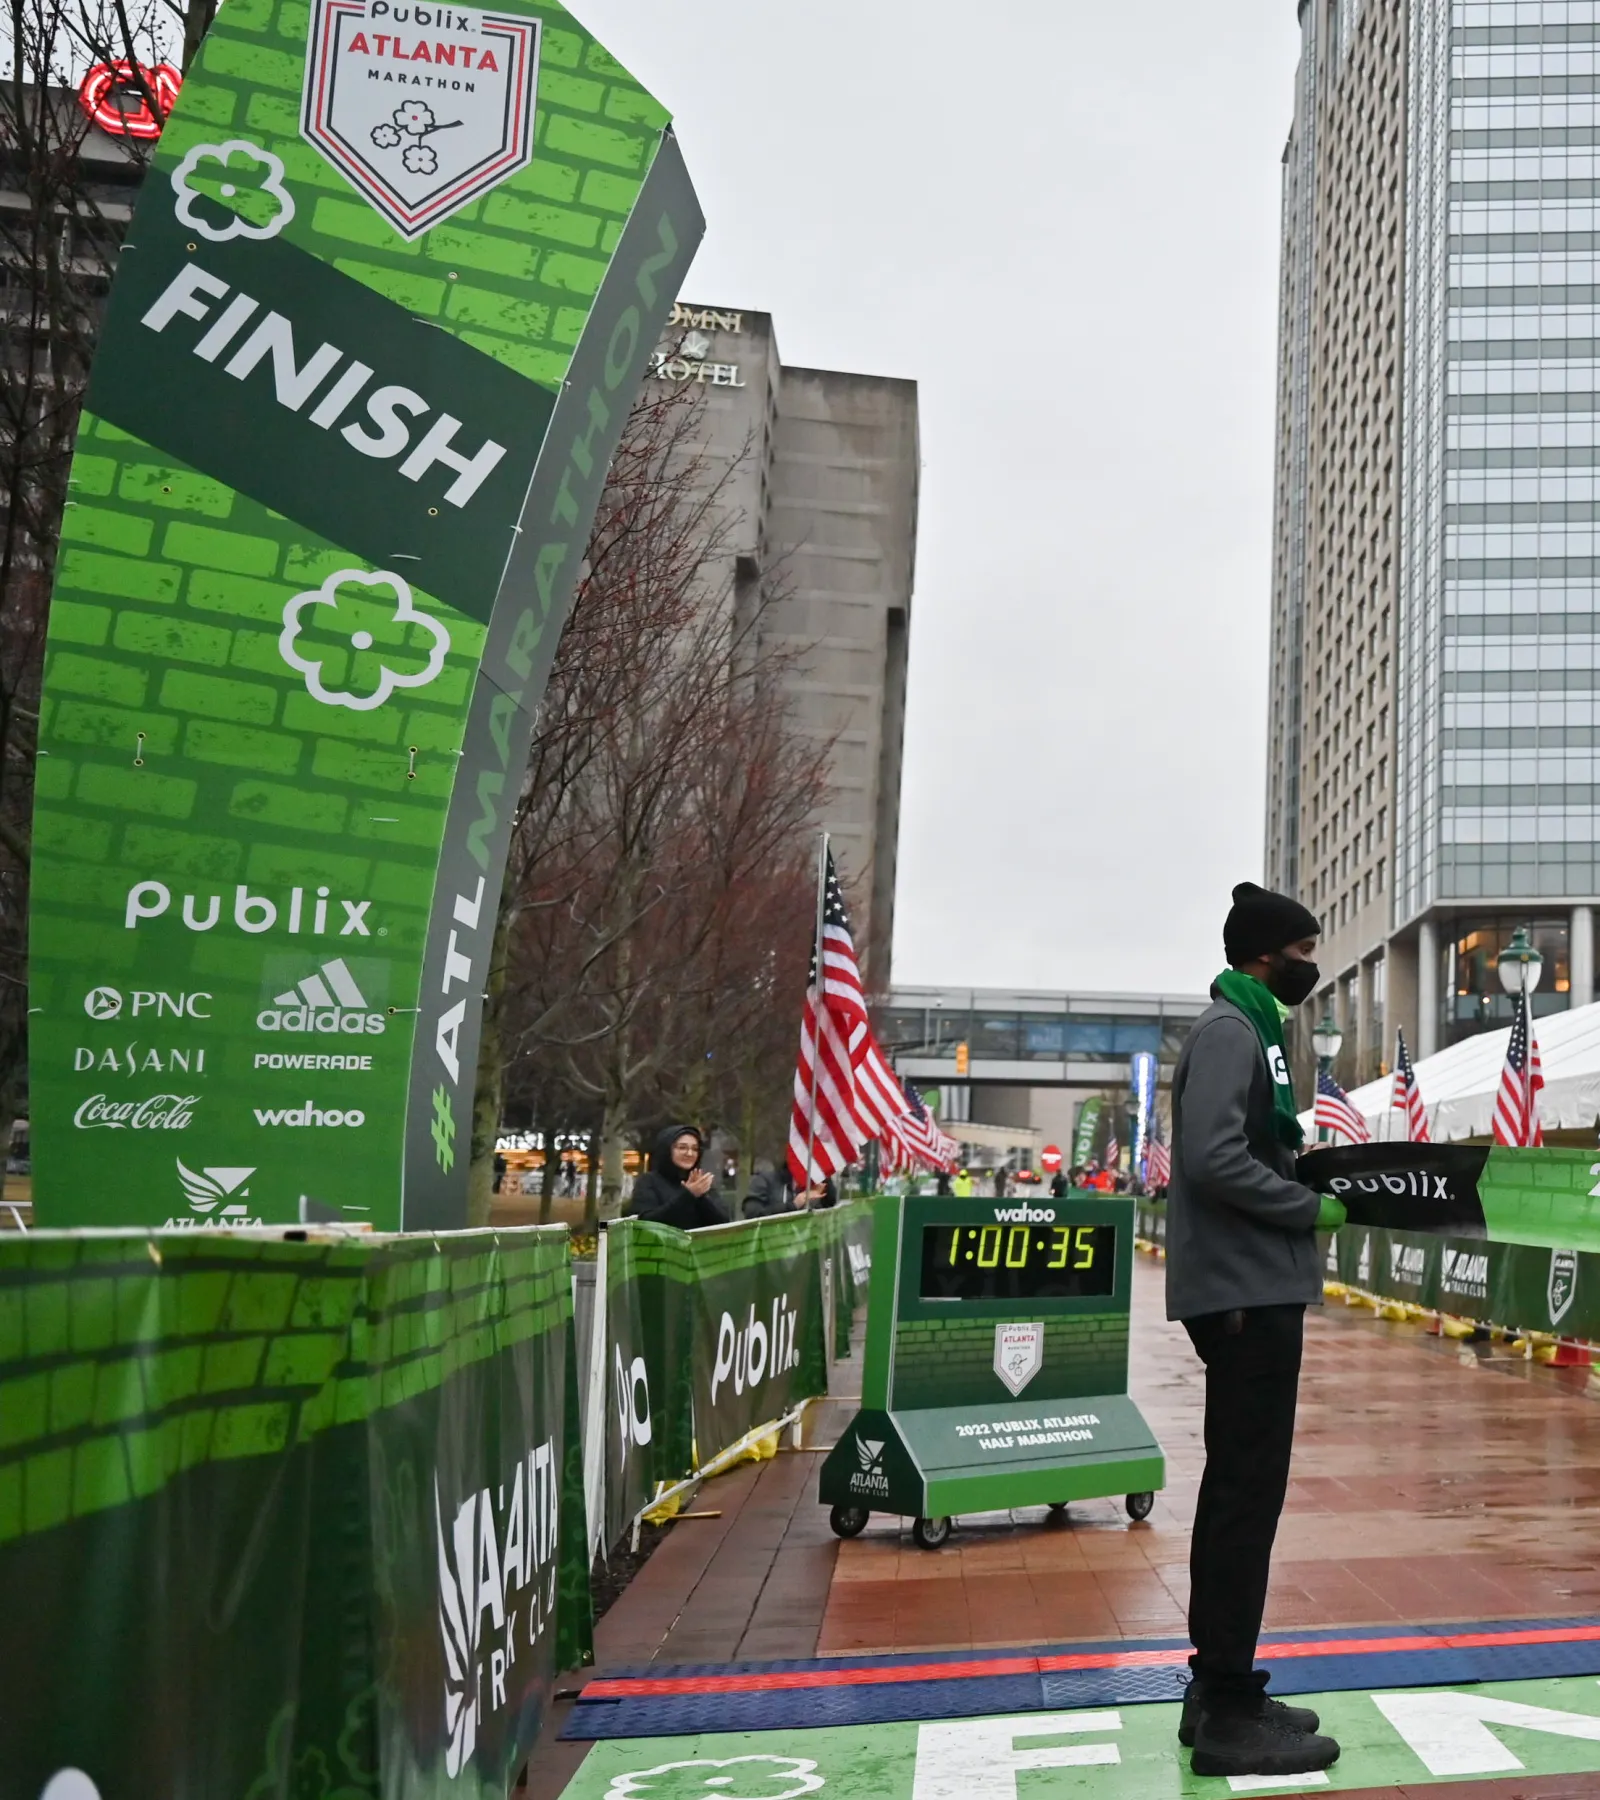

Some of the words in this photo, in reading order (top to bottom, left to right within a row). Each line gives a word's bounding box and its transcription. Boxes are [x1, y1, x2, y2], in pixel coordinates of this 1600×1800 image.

[348, 32, 499, 72] ATLANTA
[368, 69, 475, 92] MARATHON
[140, 262, 507, 508] FINISH
[130, 991, 213, 1018] PNC
[256, 1005, 386, 1034] adidas
[74, 1041, 205, 1078] DASANI
[254, 1054, 372, 1070] POWERADE
[253, 1100, 365, 1127] wahoo
[994, 1202, 1056, 1222] wahoo
[956, 1423, 989, 1437] 2022
[993, 1419, 1040, 1433] PUBLIX
[1043, 1414, 1100, 1428] ATLANTA
[979, 1436, 1015, 1450] HALF
[1016, 1429, 1093, 1446] MARATHON
[850, 1472, 889, 1490] ATLANTA
